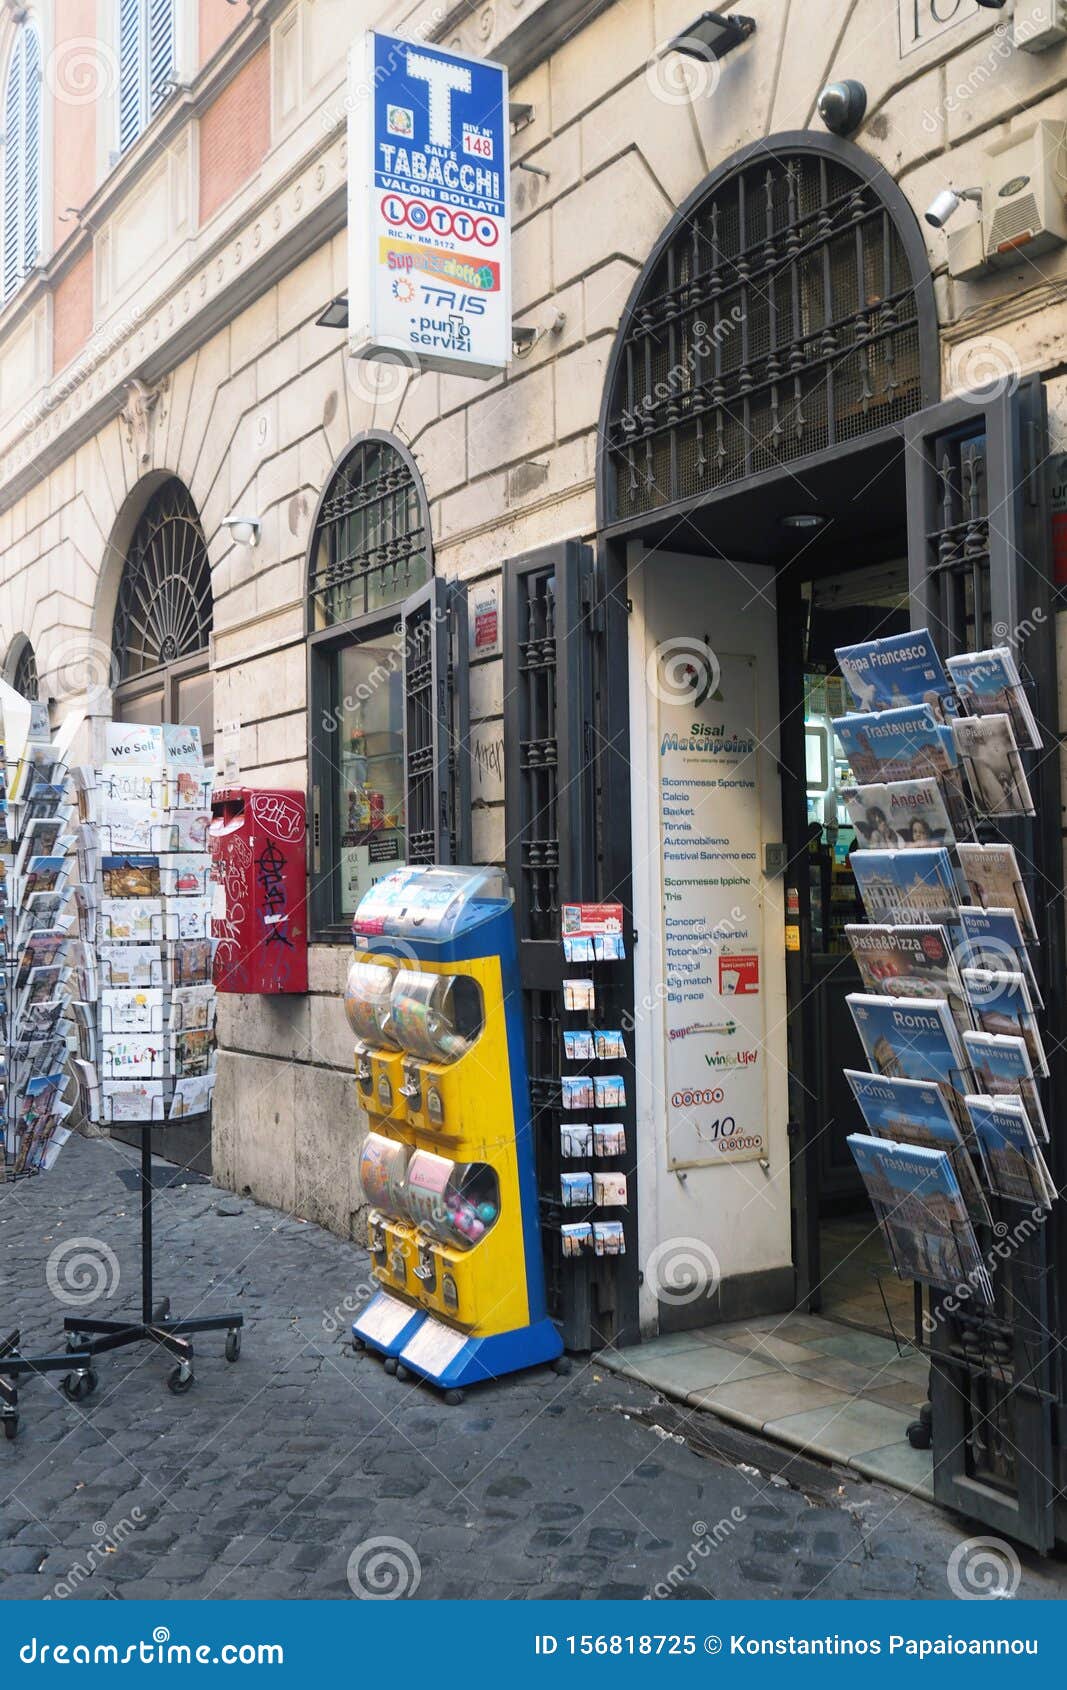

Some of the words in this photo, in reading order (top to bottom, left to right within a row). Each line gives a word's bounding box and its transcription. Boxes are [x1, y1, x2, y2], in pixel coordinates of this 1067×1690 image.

[406, 51, 472, 148] T
[424, 144, 447, 157] SALI
[450, 151, 457, 160] E
[464, 136, 491, 157] 148
[379, 143, 500, 199] TABACCHI
[381, 177, 436, 199] VALORI
[440, 191, 500, 215] BOLLATI
[381, 194, 499, 247] LOTTO
[420, 286, 487, 315] TRIS
[410, 331, 471, 353] servizi
[869, 644, 927, 668] Francesco
[691, 724, 725, 737] Sisal
[111, 745, 131, 757] We
[133, 742, 155, 753] Sell
[168, 747, 181, 757] We
[182, 743, 197, 754] Sell
[660, 733, 754, 756] Matchpoint
[662, 777, 718, 787] Scommesse
[718, 778, 755, 788] Sportive
[662, 793, 690, 801] Calcio
[890, 789, 933, 811] Angeli
[663, 822, 692, 831] Tennis
[664, 837, 729, 846] Automobilismo
[664, 852, 699, 861] Festival
[700, 852, 740, 860] Sanremo
[664, 877, 719, 887] Scommesse
[720, 876, 751, 888] Ippiche
[665, 892, 682, 901] Tris
[892, 910, 933, 925] ROMA
[965, 917, 991, 928] Roma
[852, 934, 922, 951] Pasta&Pizza
[683, 976, 712, 985] match
[667, 992, 683, 1002] Big
[892, 1011, 940, 1030] Roma
[970, 1045, 1020, 1061] Trastevere
[853, 1079, 896, 1100] Roma
[671, 1088, 725, 1108] LOTTO
[711, 1116, 735, 1140] 10
[992, 1113, 1022, 1128] Roma
[718, 1134, 763, 1152] LOTTO
[878, 1153, 939, 1179] Trastevere
